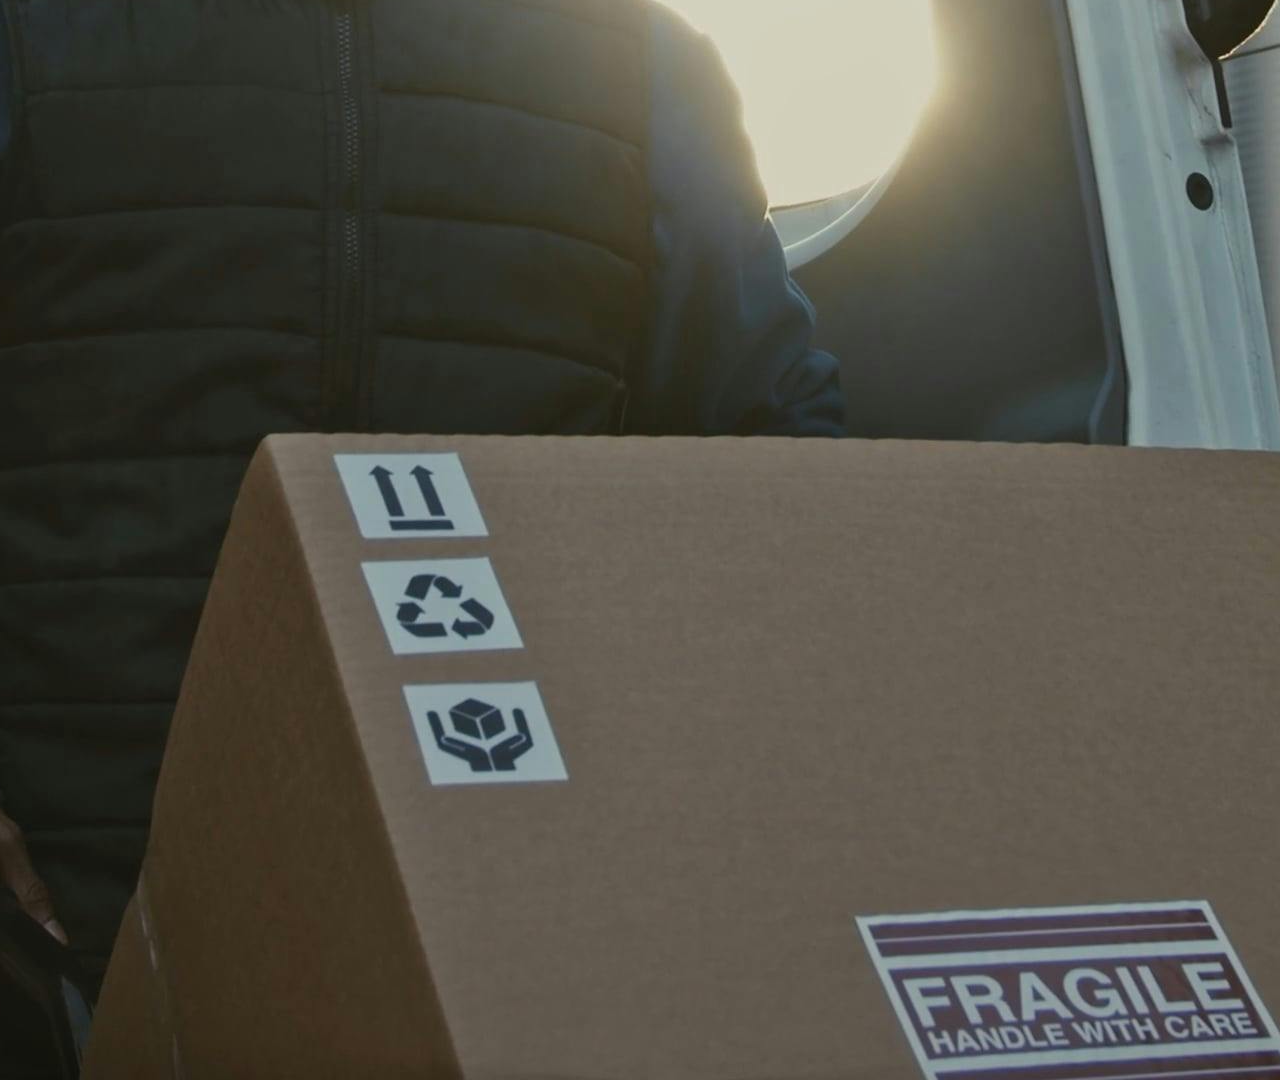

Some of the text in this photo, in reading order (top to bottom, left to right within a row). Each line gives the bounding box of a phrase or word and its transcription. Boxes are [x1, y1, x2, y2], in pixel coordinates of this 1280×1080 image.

[902, 962, 1245, 1028] FRAGILE
[927, 1012, 1258, 1055] HANDLE WITH CARE
